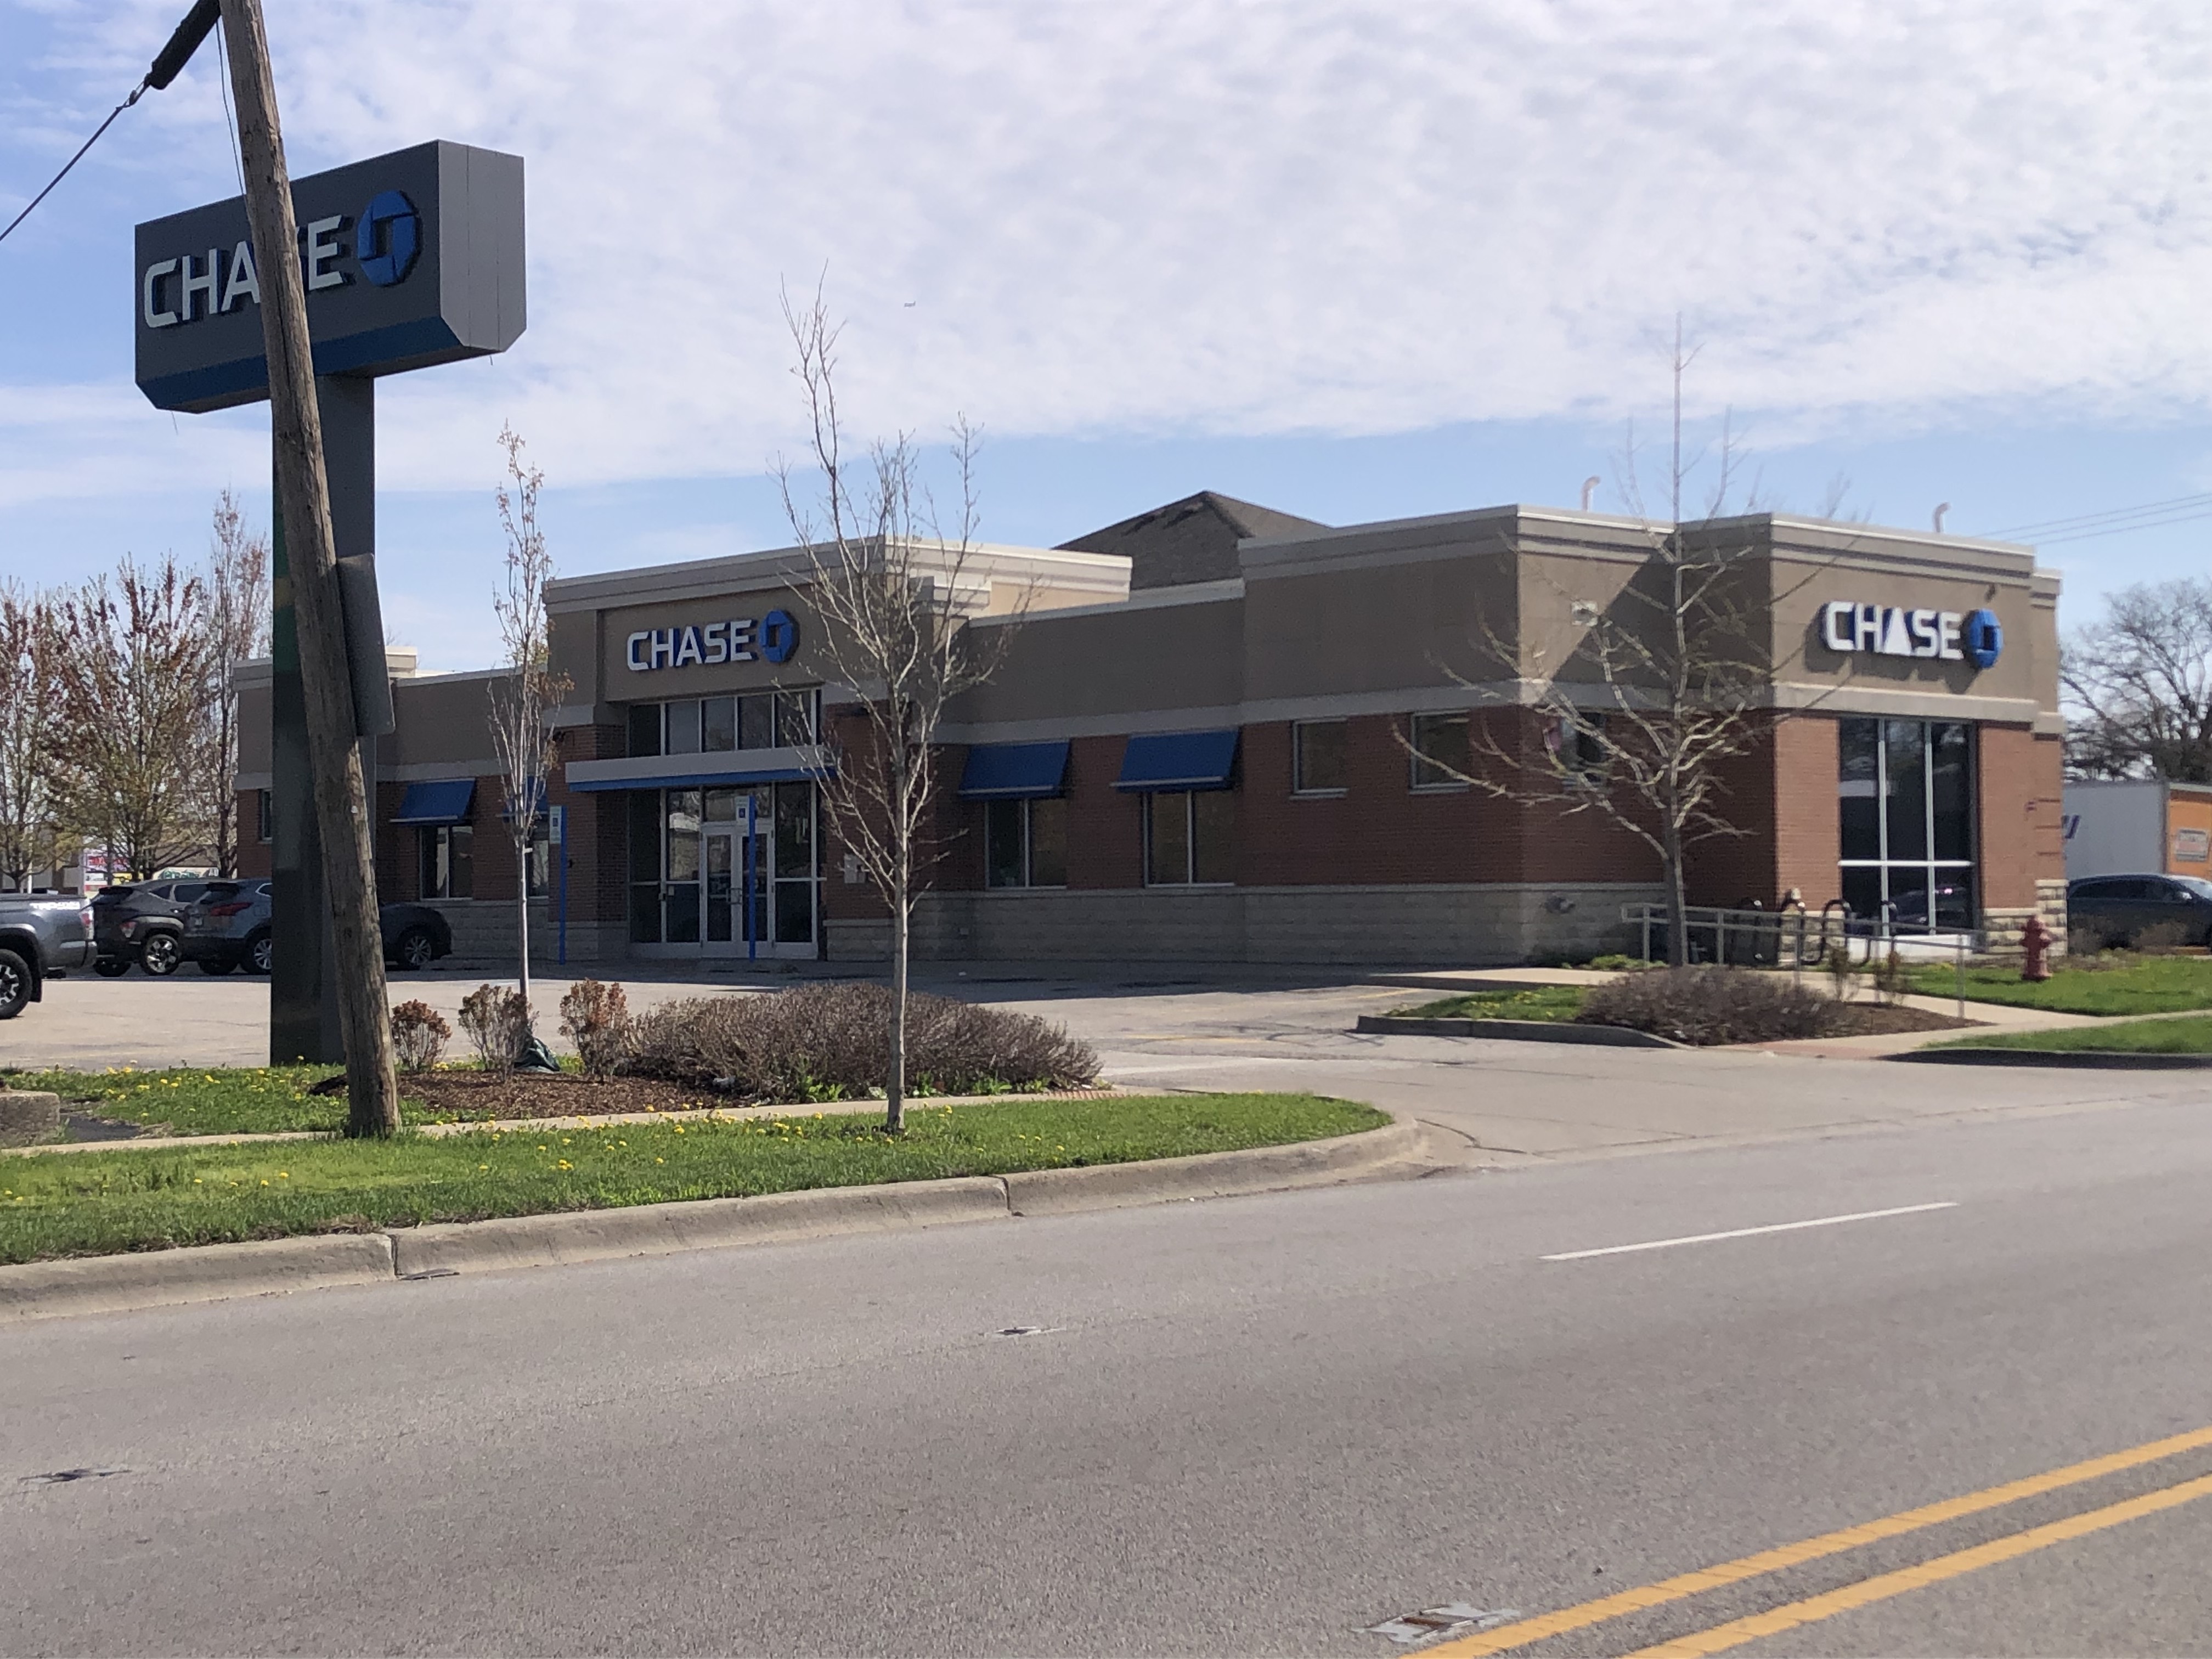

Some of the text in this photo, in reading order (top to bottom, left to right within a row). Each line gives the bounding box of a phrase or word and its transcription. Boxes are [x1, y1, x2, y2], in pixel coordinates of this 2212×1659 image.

[144, 215, 343, 328] CHAE
[628, 619, 752, 670] CHASE
[1826, 601, 1964, 659] CHASE
